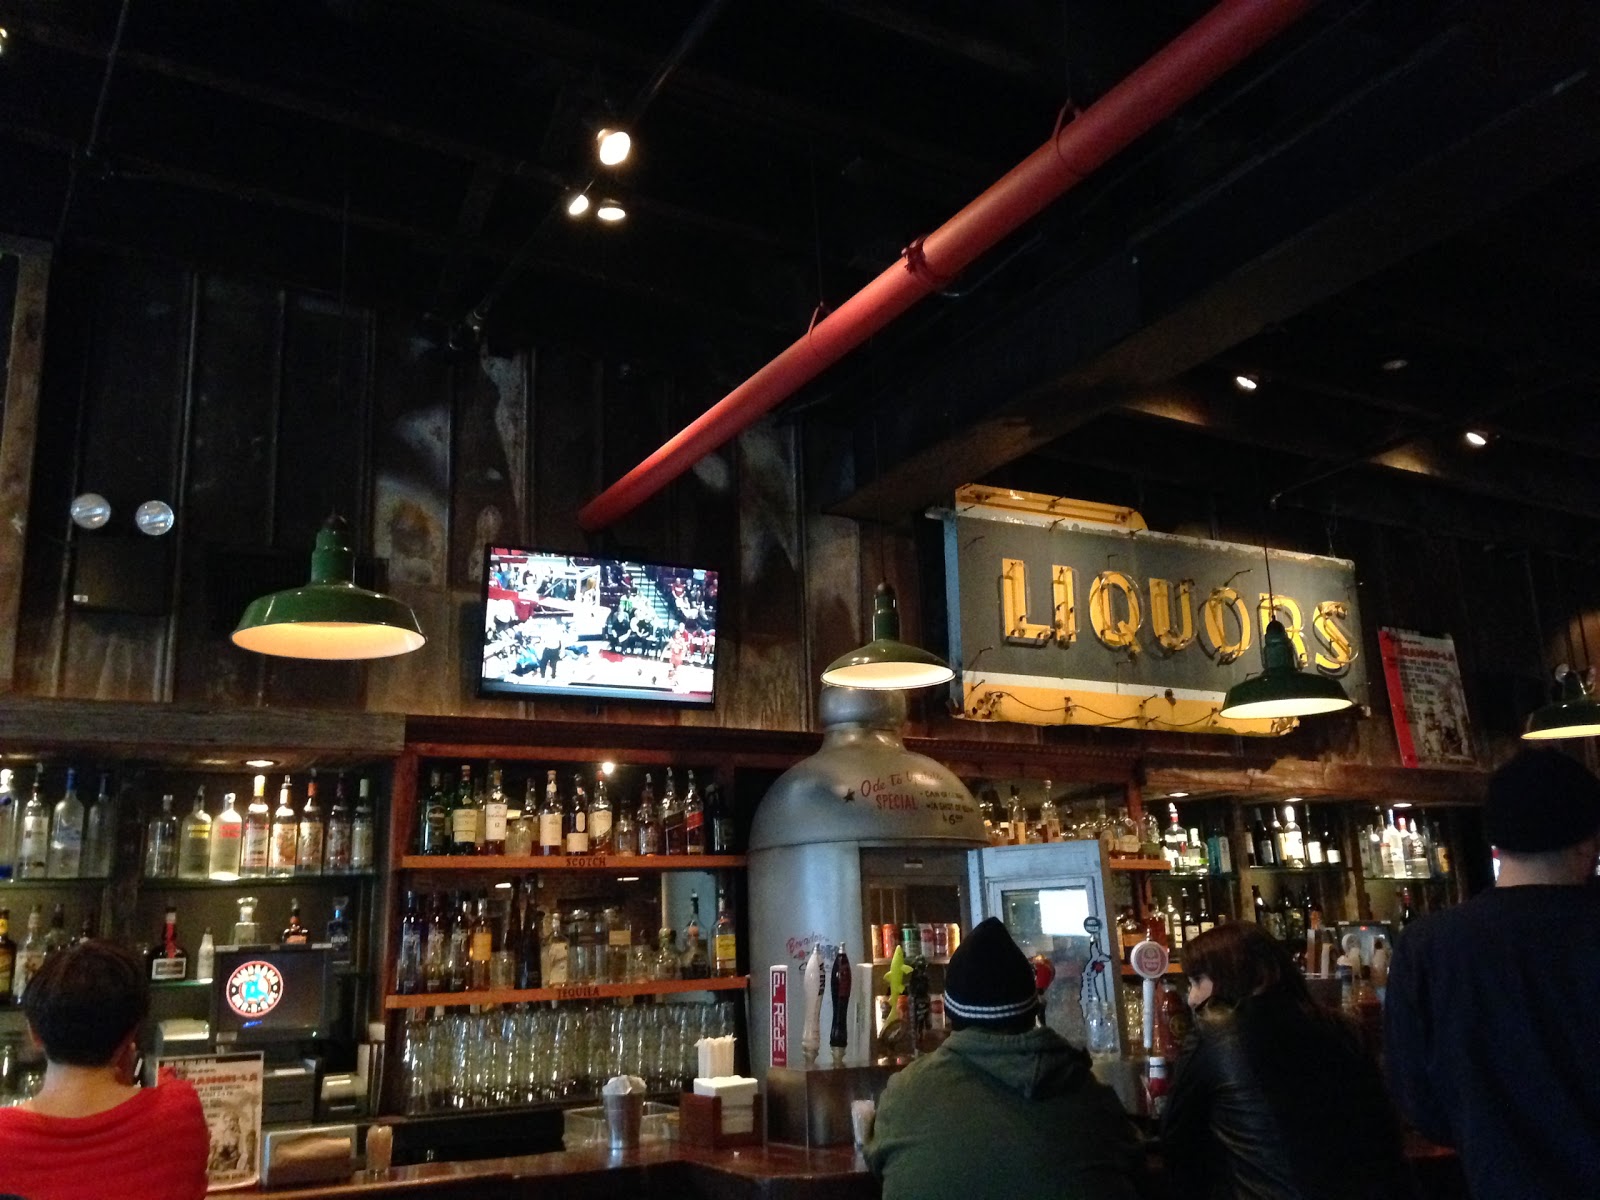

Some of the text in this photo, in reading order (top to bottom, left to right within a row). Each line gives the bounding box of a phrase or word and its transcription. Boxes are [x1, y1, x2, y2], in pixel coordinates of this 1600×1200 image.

[1002, 557, 1359, 671] LIQUORS
[875, 794, 918, 810] SPECIAL
[566, 857, 606, 867] SCOTCH
[557, 986, 599, 999] TEQUILA
